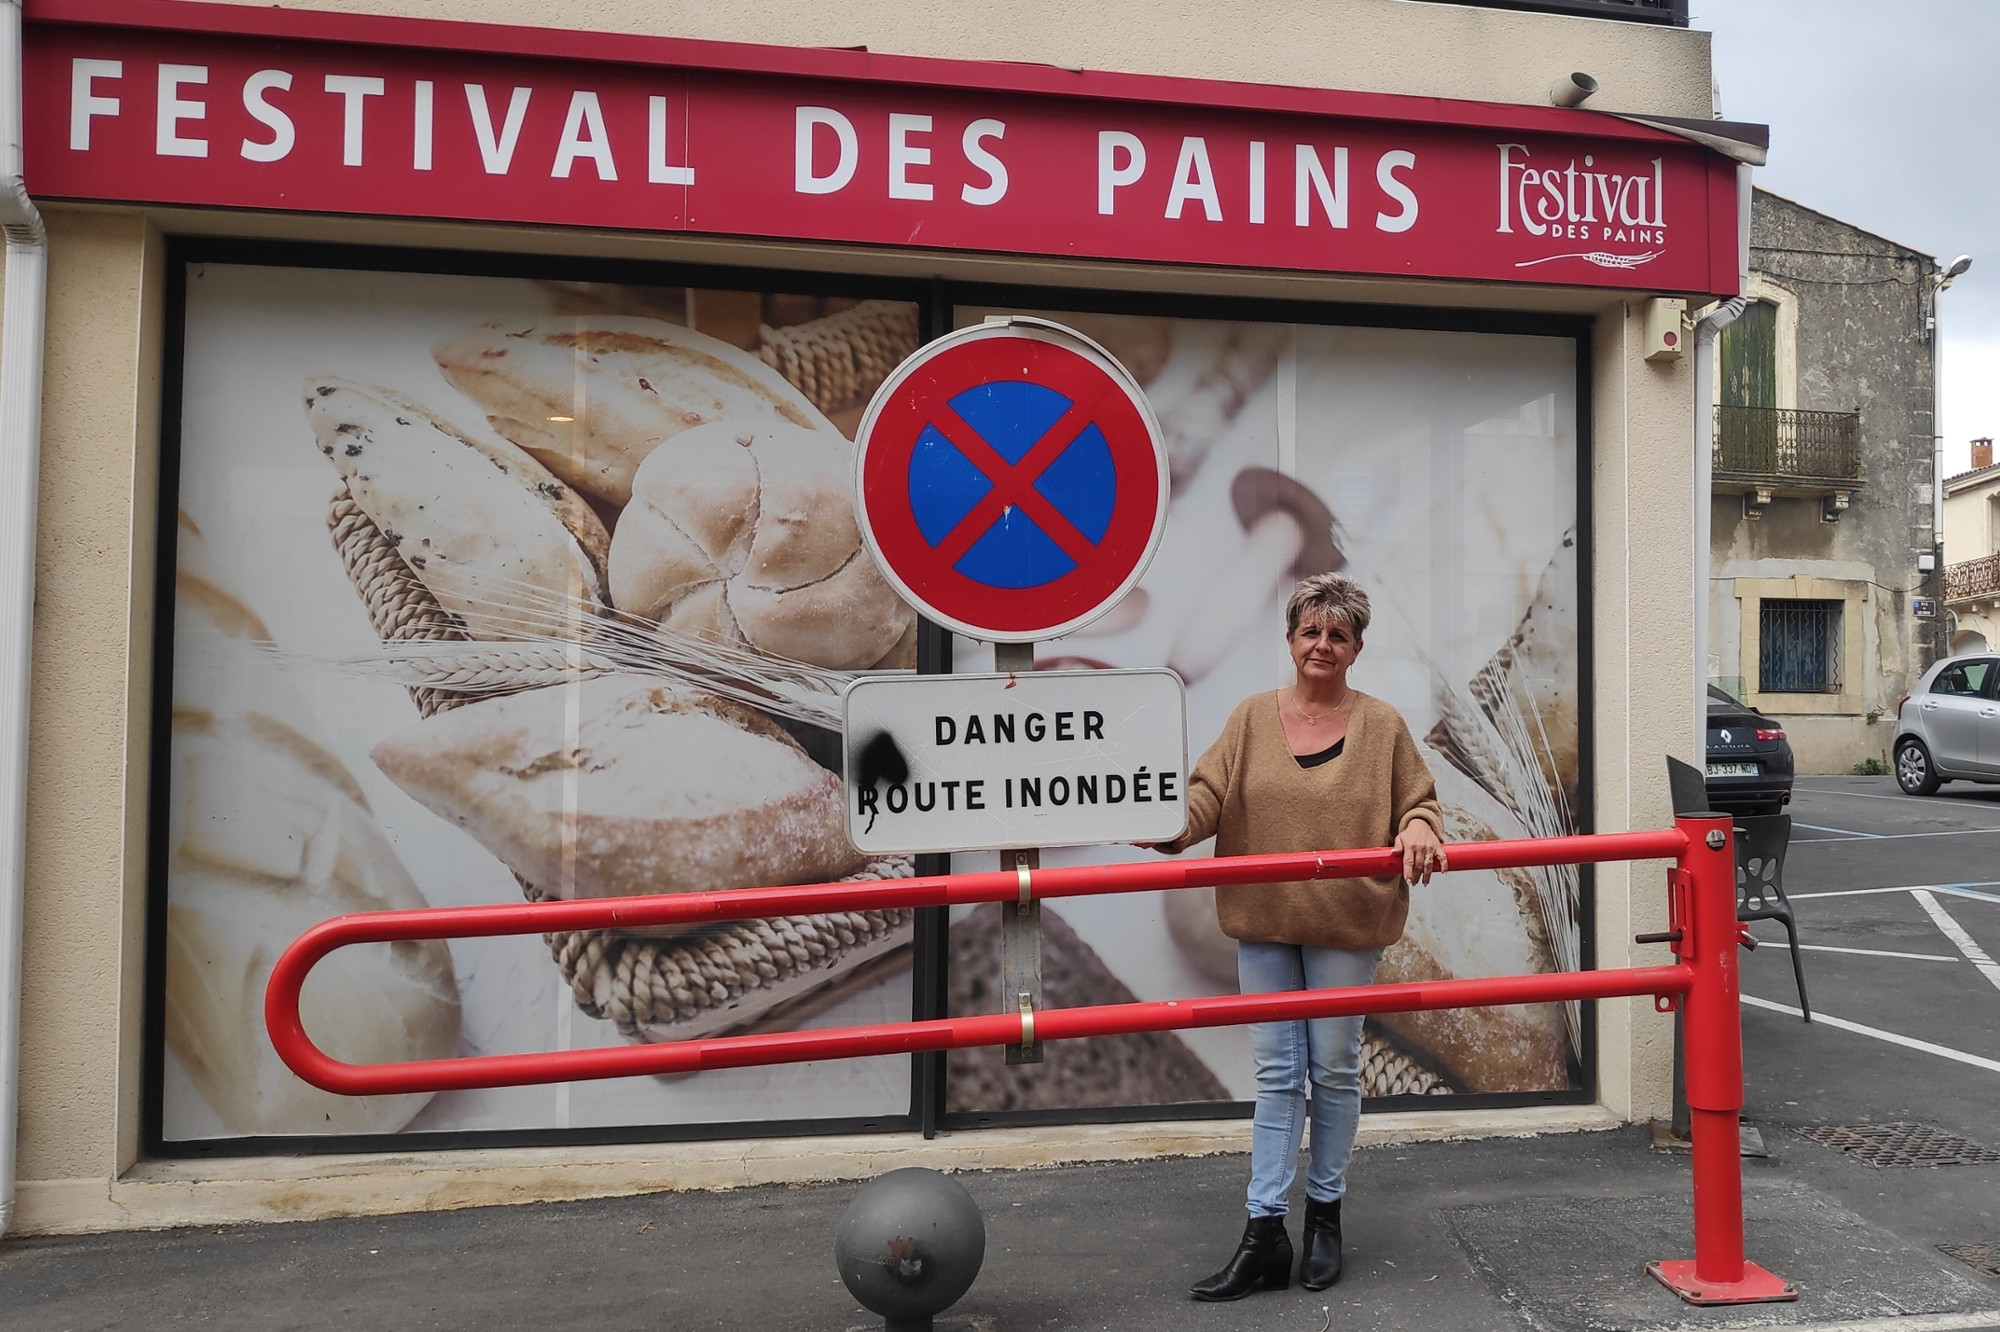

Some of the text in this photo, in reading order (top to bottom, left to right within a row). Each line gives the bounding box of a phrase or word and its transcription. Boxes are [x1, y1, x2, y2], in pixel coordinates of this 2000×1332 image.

[69, 57, 1419, 233] FESTIVAL DES PAINS
[1496, 143, 1667, 235] Festival
[1551, 223, 1666, 244] DES PAINS
[934, 710, 1105, 746] DANGER
[857, 765, 1178, 816] ROUTE INONDÉE
